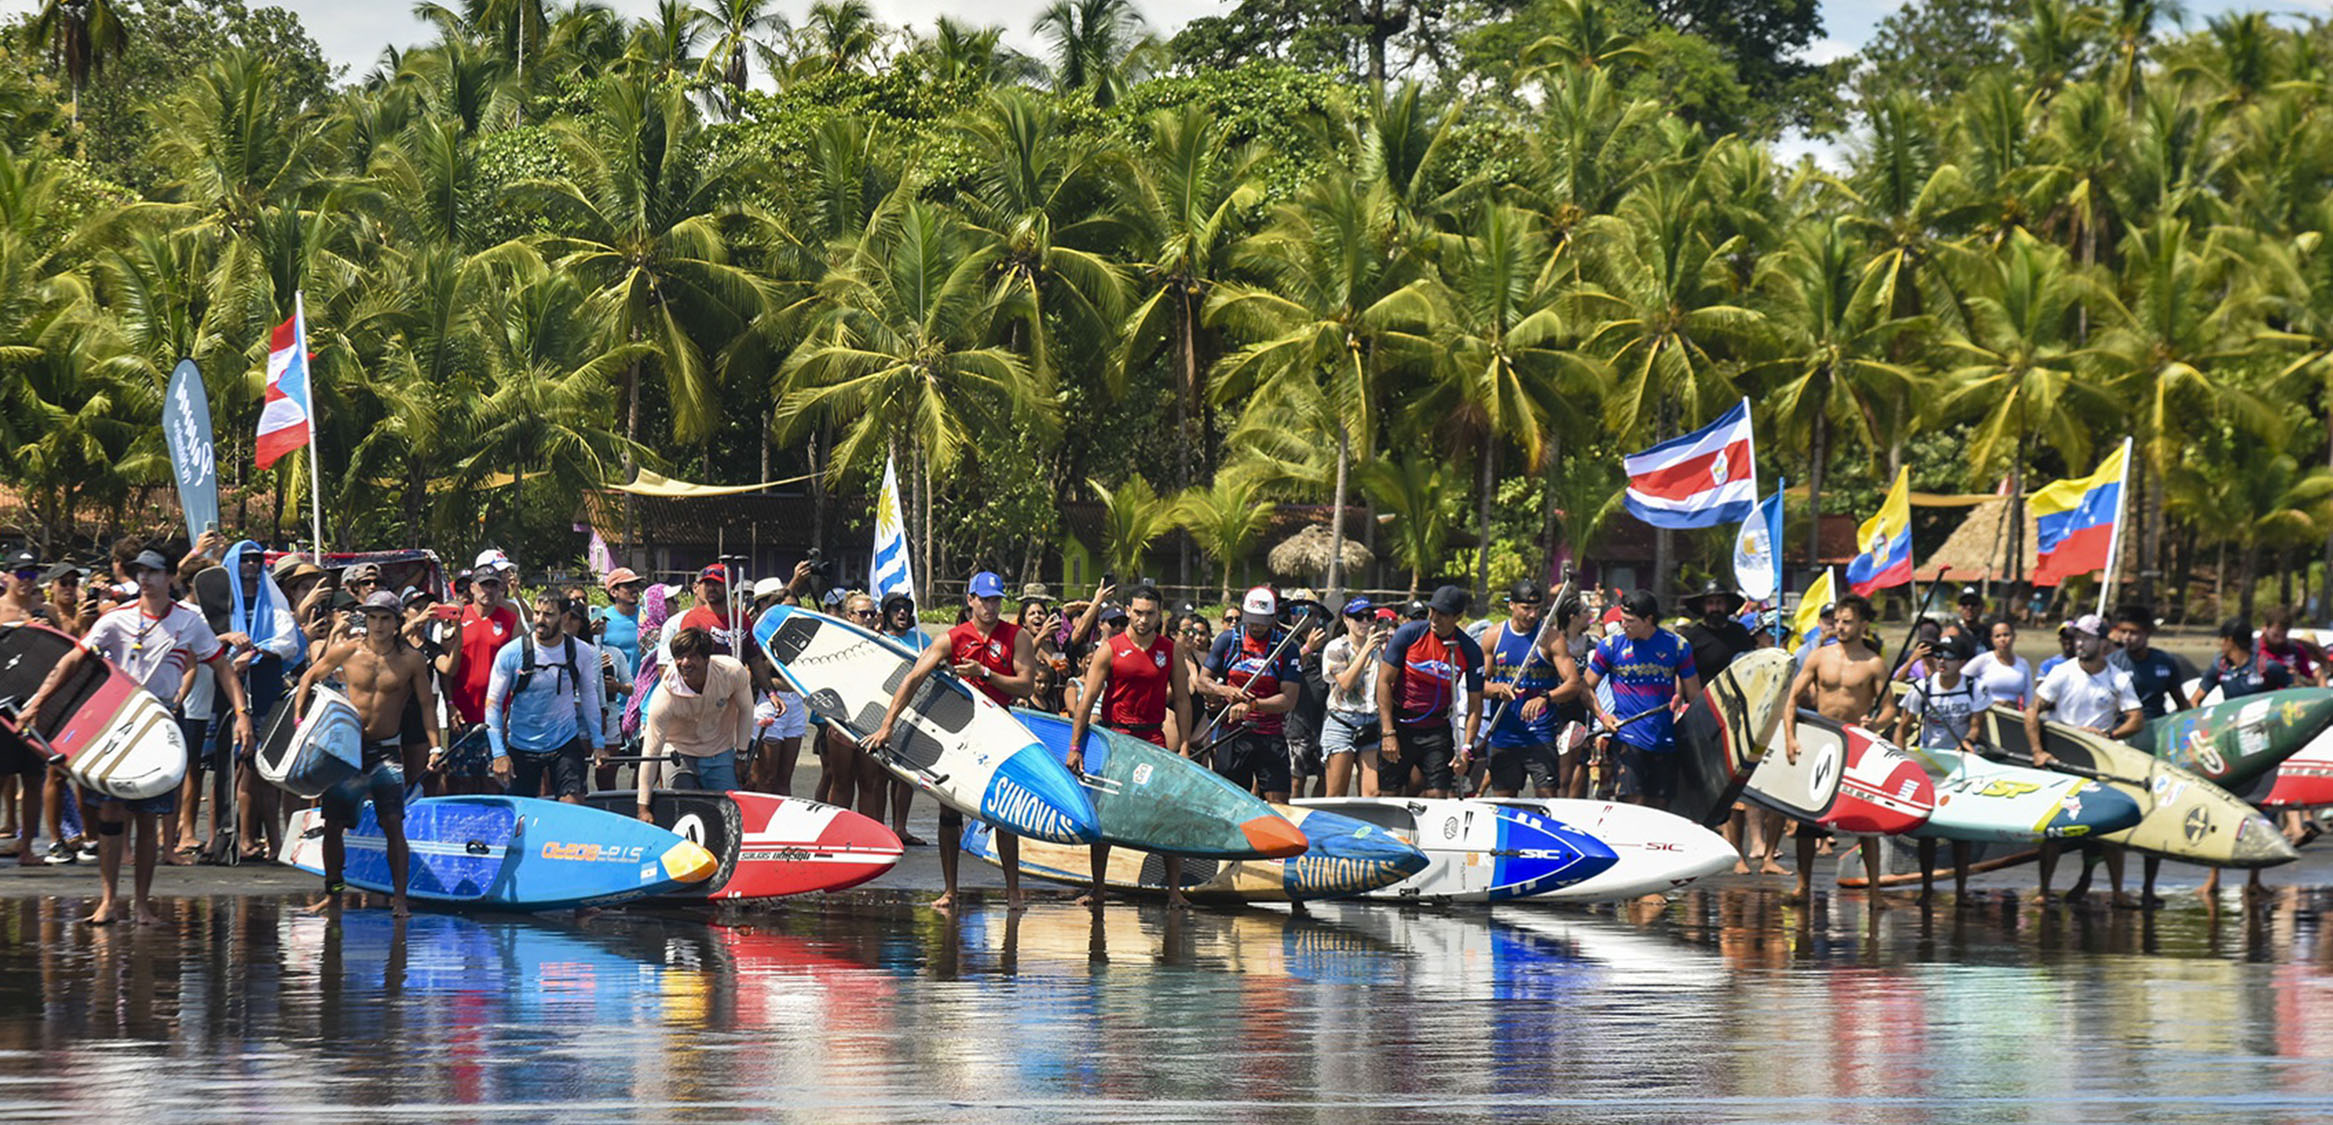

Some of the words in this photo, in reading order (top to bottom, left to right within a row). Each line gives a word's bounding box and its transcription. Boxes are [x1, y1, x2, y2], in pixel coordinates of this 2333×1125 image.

[987, 776, 1058, 844] SUNOVA
[1518, 848, 1560, 860] SIC
[1645, 842, 1686, 853] SIC
[1294, 855, 1378, 890] SUNOVA
